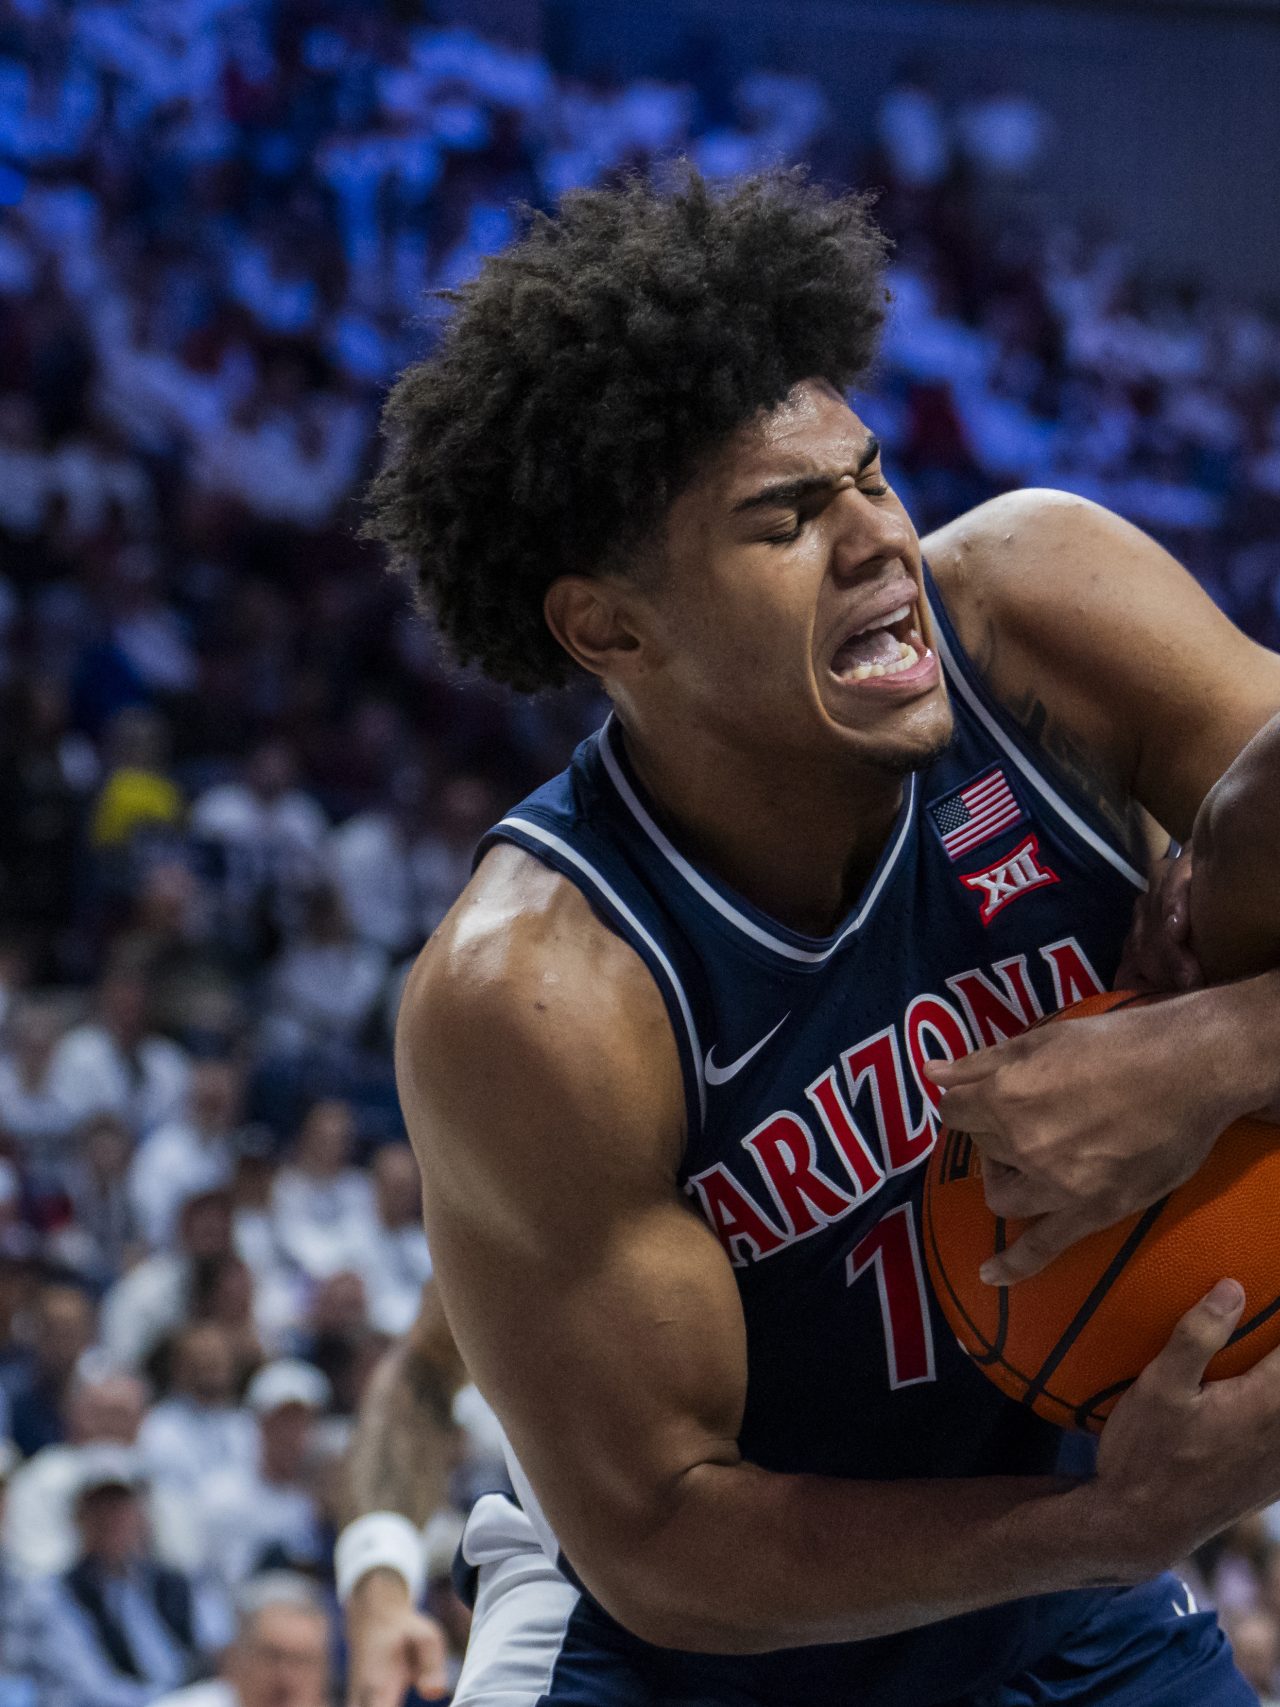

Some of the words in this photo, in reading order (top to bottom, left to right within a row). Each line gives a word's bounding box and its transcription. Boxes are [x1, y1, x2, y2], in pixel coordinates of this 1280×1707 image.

[963, 838, 1054, 920] XII
[688, 936, 1108, 1268] ARIZONA
[846, 1201, 972, 1391] 1
